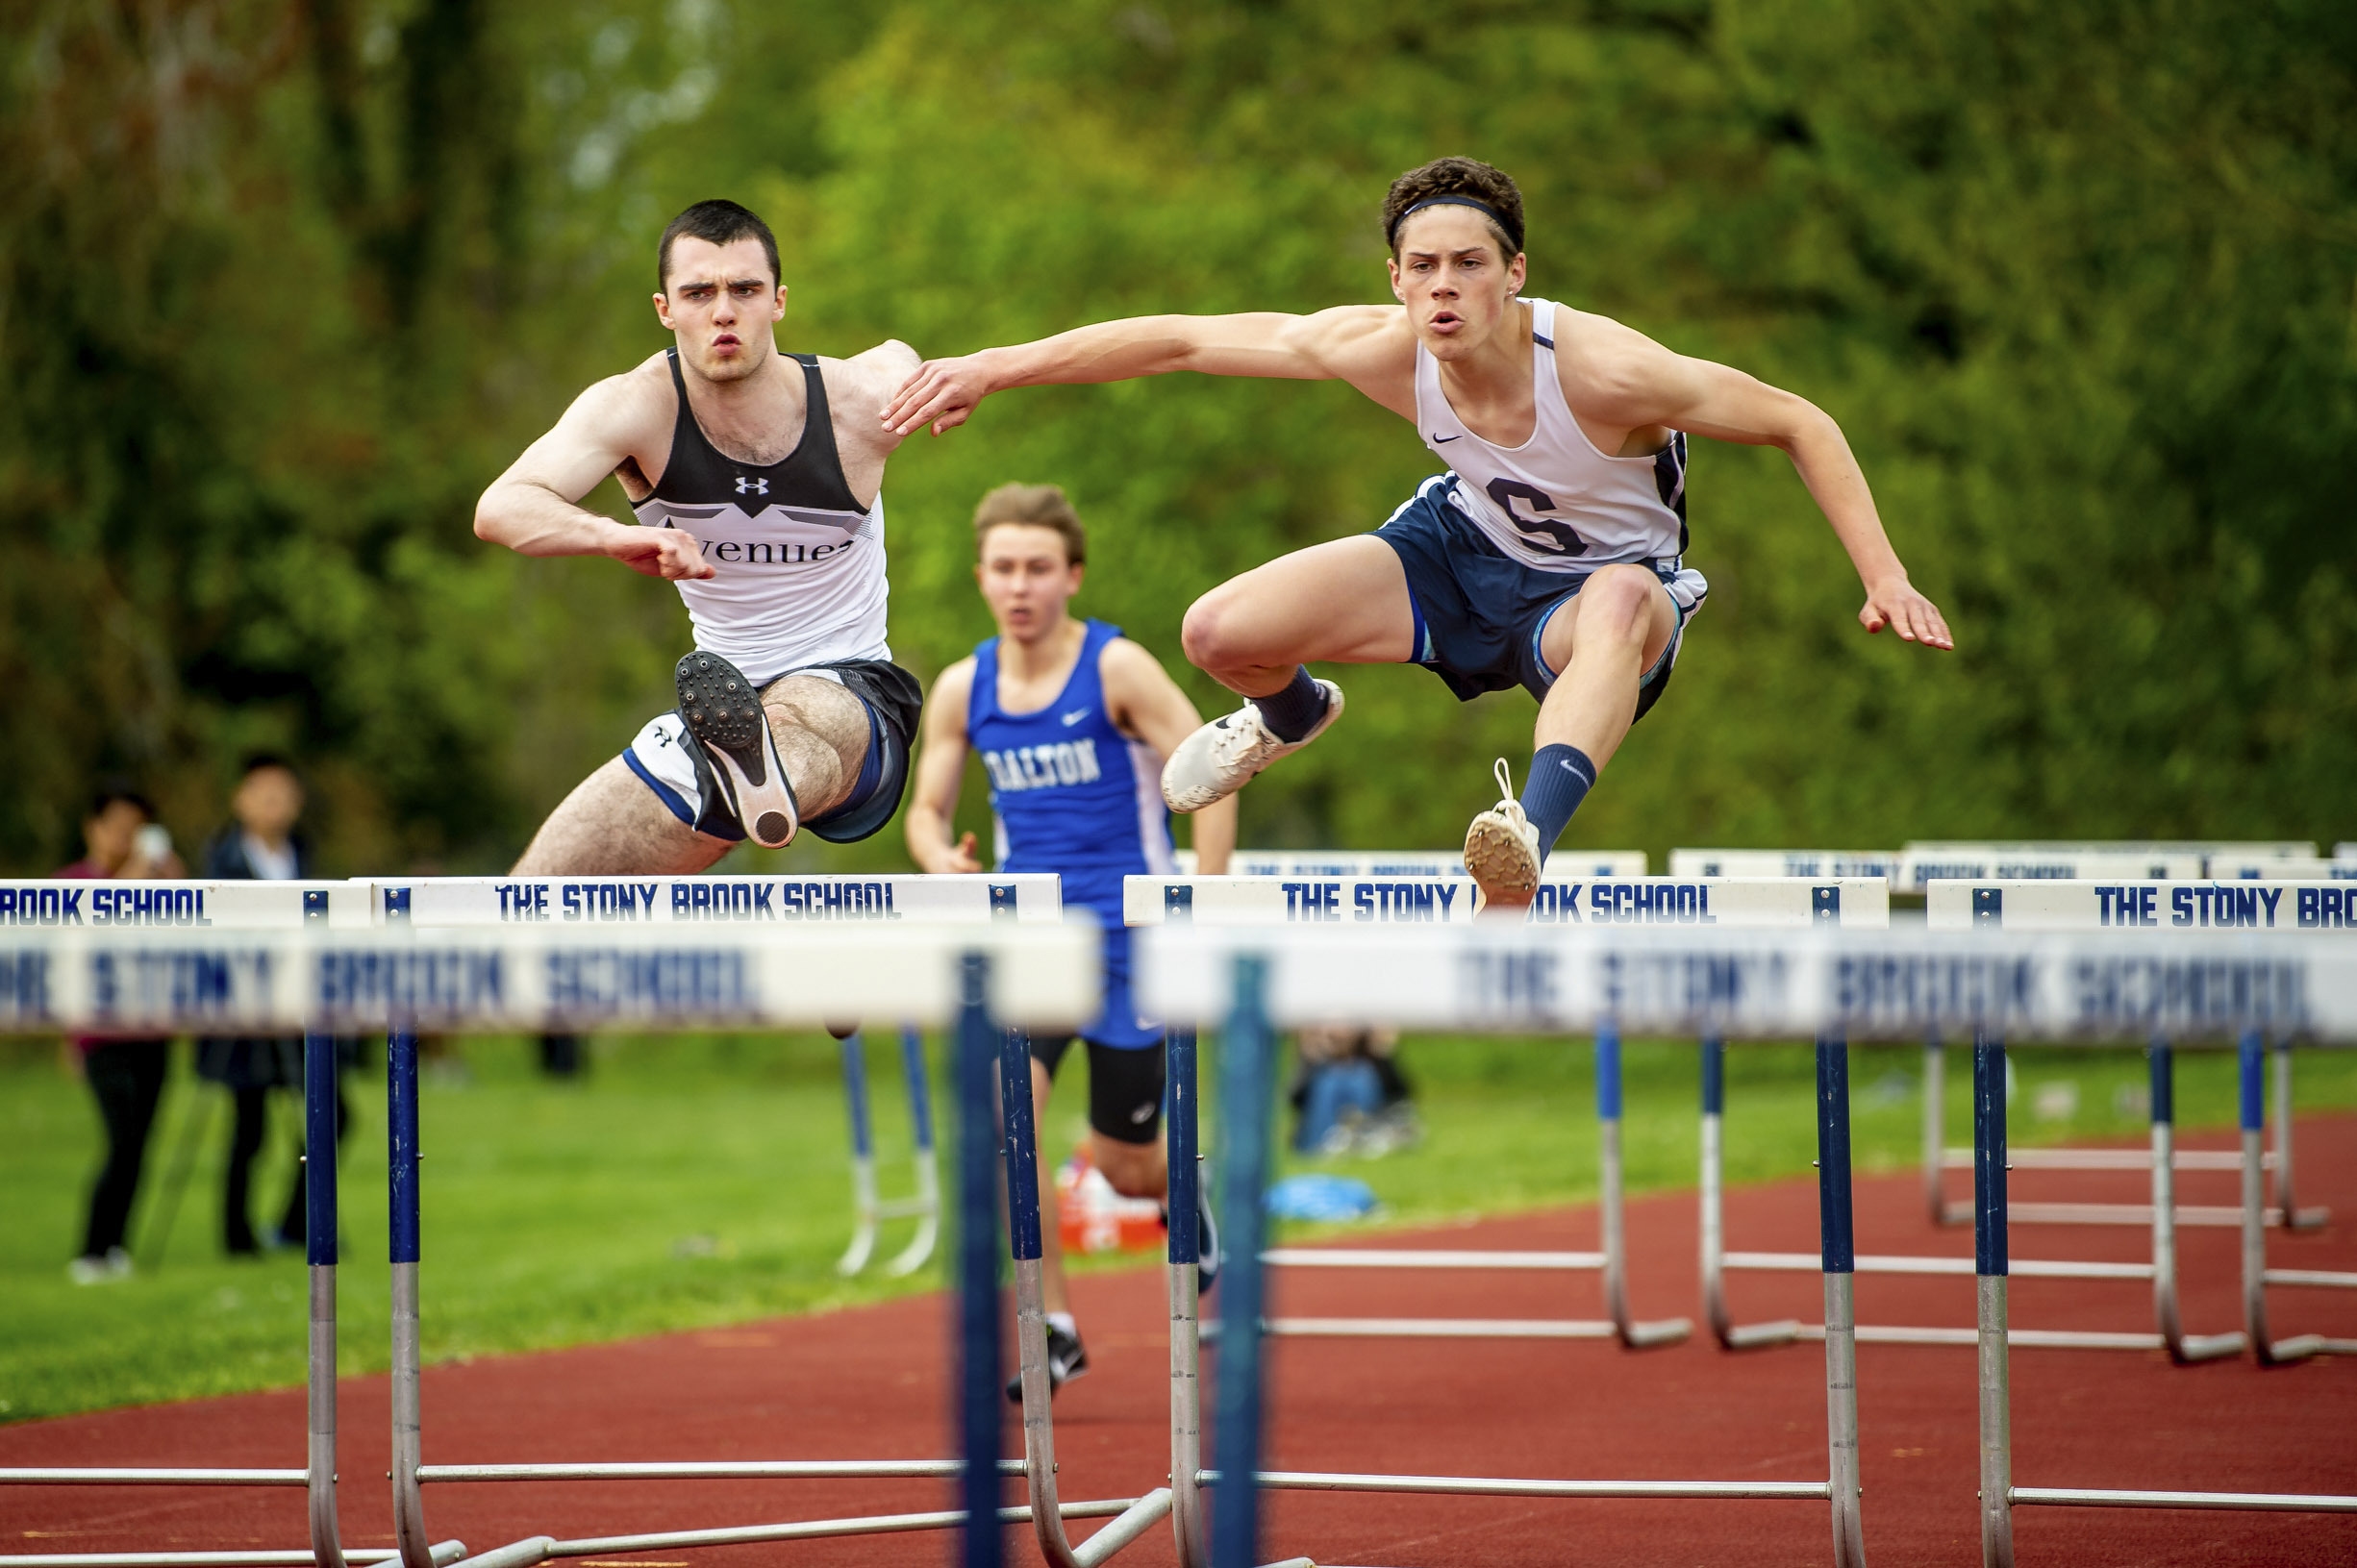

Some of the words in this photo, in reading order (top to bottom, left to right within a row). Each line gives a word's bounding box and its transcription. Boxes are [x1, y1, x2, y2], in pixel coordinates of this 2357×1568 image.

[1486, 477, 1589, 557] S
[92, 888, 212, 926] SCHOOL
[495, 884, 550, 922] THE
[563, 884, 657, 922] STONY
[672, 883, 776, 922] BROOK
[784, 883, 901, 921] SCHOOL
[1282, 883, 1341, 922] THE
[1354, 883, 1458, 923] STONY
[1591, 884, 1718, 924] SCHOOL
[2094, 886, 2158, 927] THE
[2171, 886, 2283, 928] STONY
